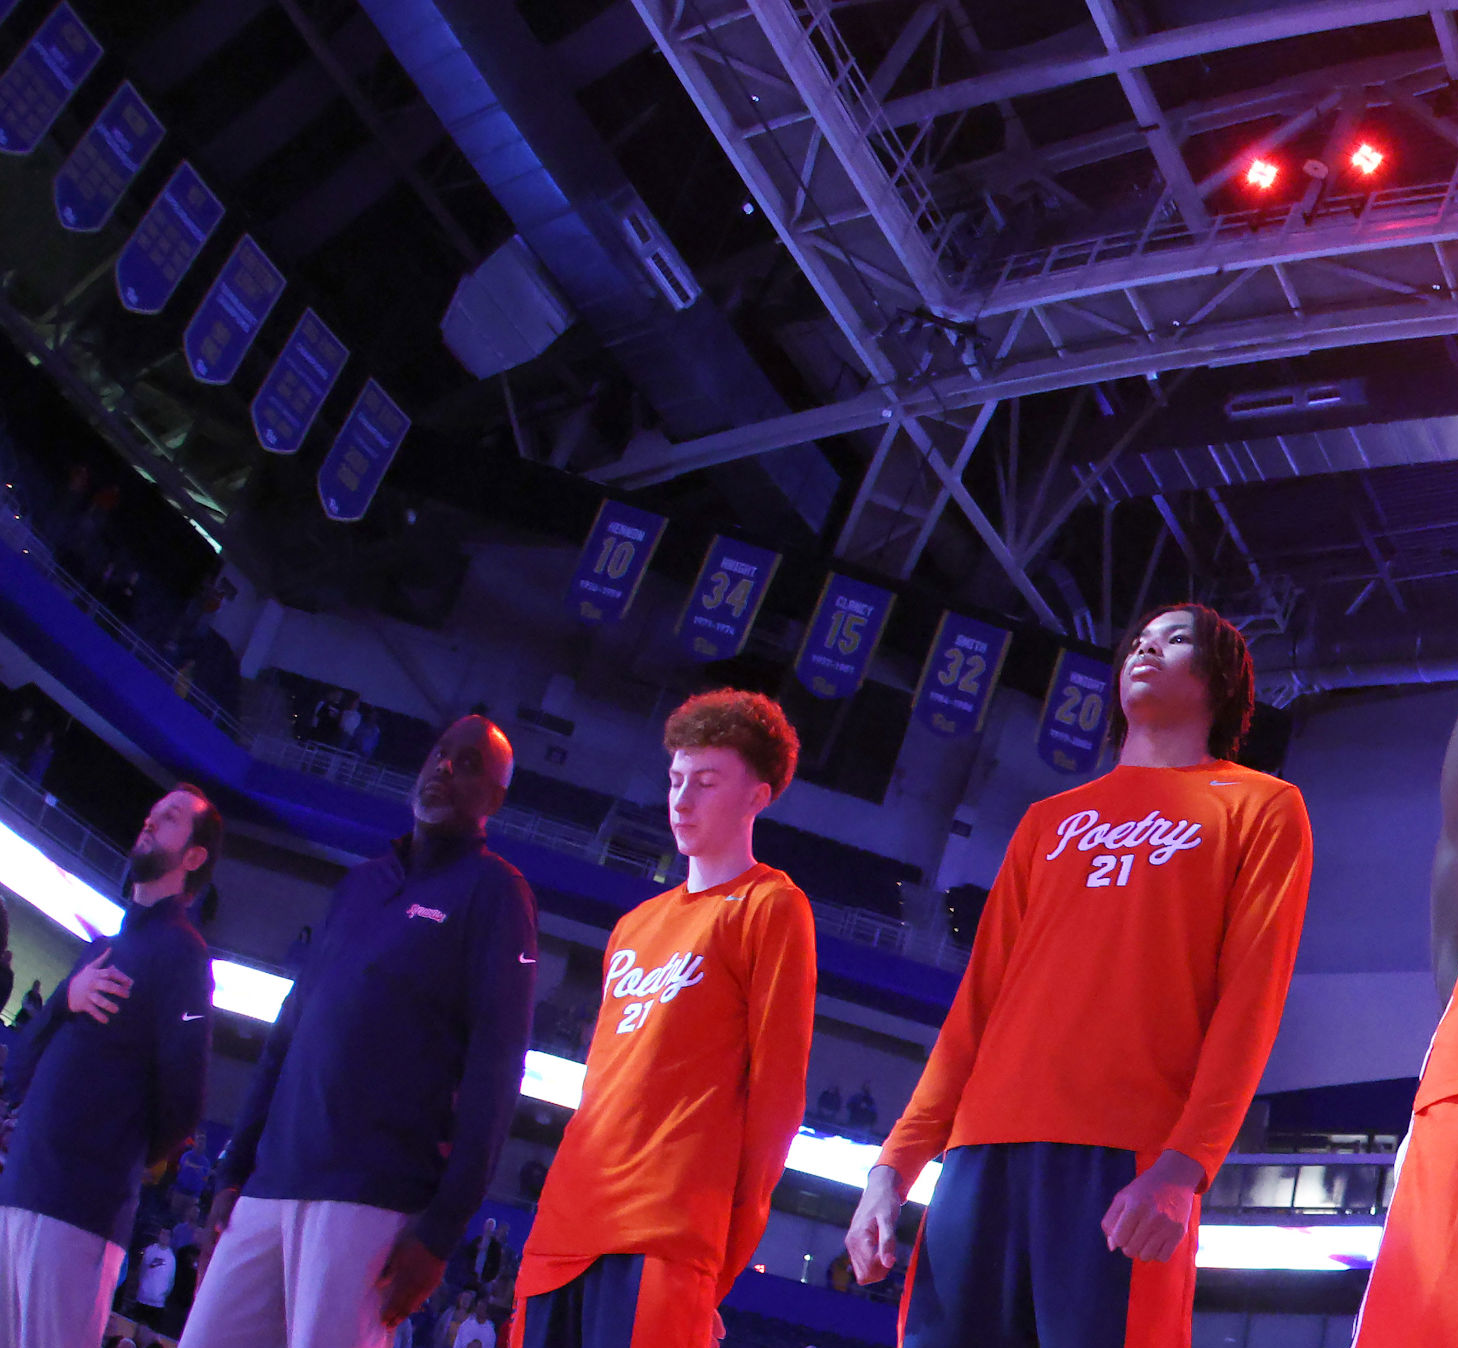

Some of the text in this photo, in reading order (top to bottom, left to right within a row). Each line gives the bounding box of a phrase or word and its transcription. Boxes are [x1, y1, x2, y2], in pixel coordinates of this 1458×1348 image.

[593, 536, 635, 579] 10
[702, 571, 754, 617] 34
[823, 610, 868, 656] 15
[937, 647, 987, 696] 32
[1054, 685, 1103, 732] 20
[1046, 809, 1203, 866] Poetry
[1086, 854, 1135, 888] 21
[602, 949, 705, 1003] Poetry
[615, 1001, 655, 1034] 21
